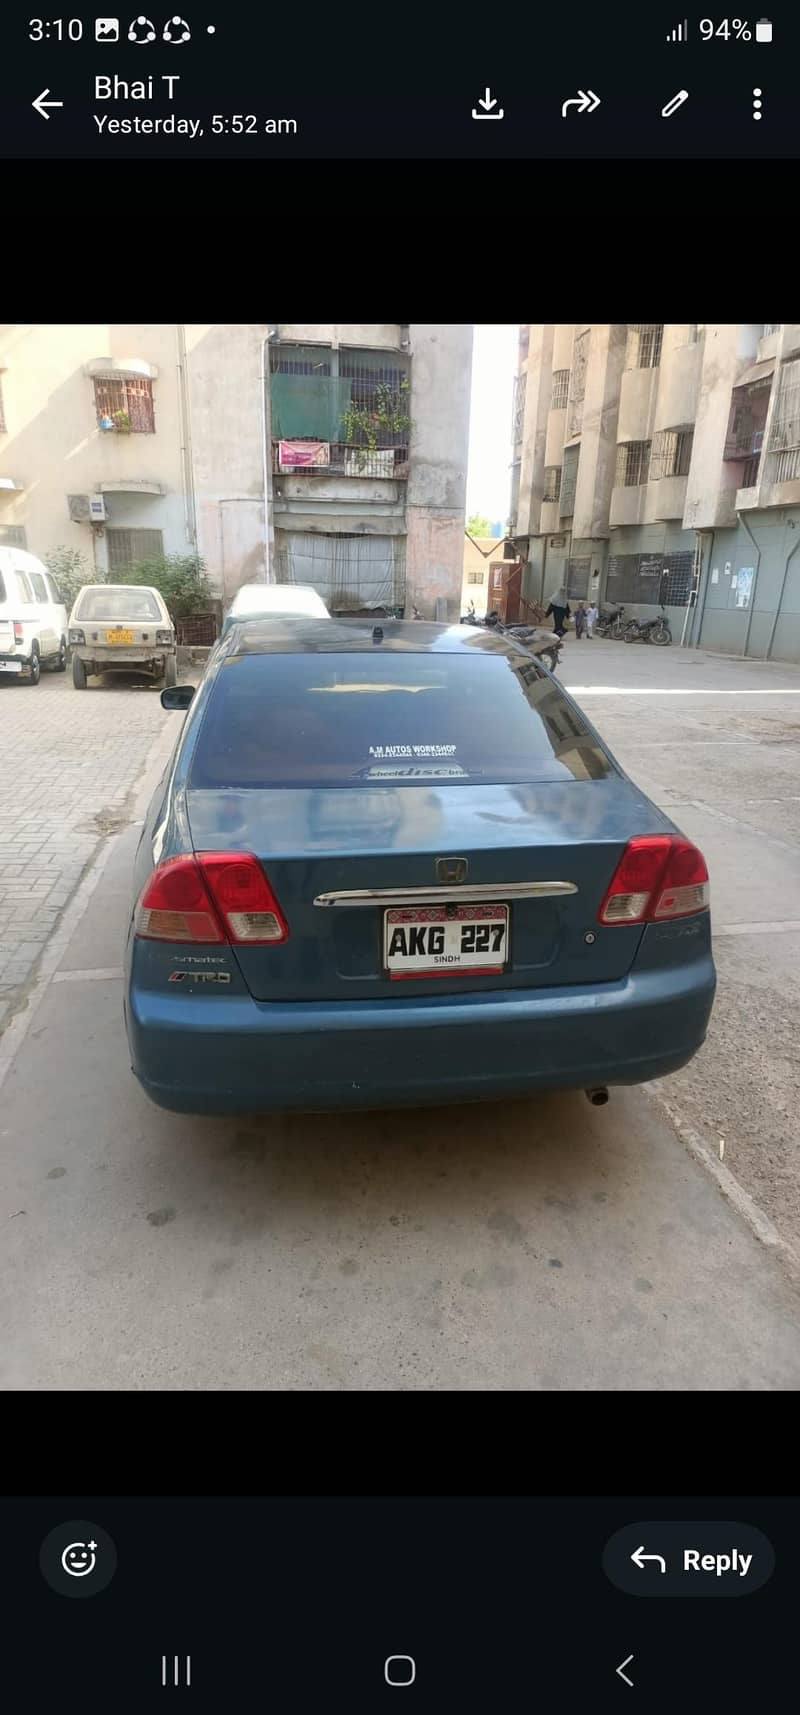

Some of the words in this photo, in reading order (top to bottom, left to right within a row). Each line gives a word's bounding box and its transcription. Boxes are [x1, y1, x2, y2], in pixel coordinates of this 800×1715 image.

[385, 745, 412, 754] AUTOS
[412, 744, 457, 753] WORKSHOP
[388, 926, 445, 957] AKG
[461, 924, 506, 954] 227
[433, 955, 461, 964] SINDH
